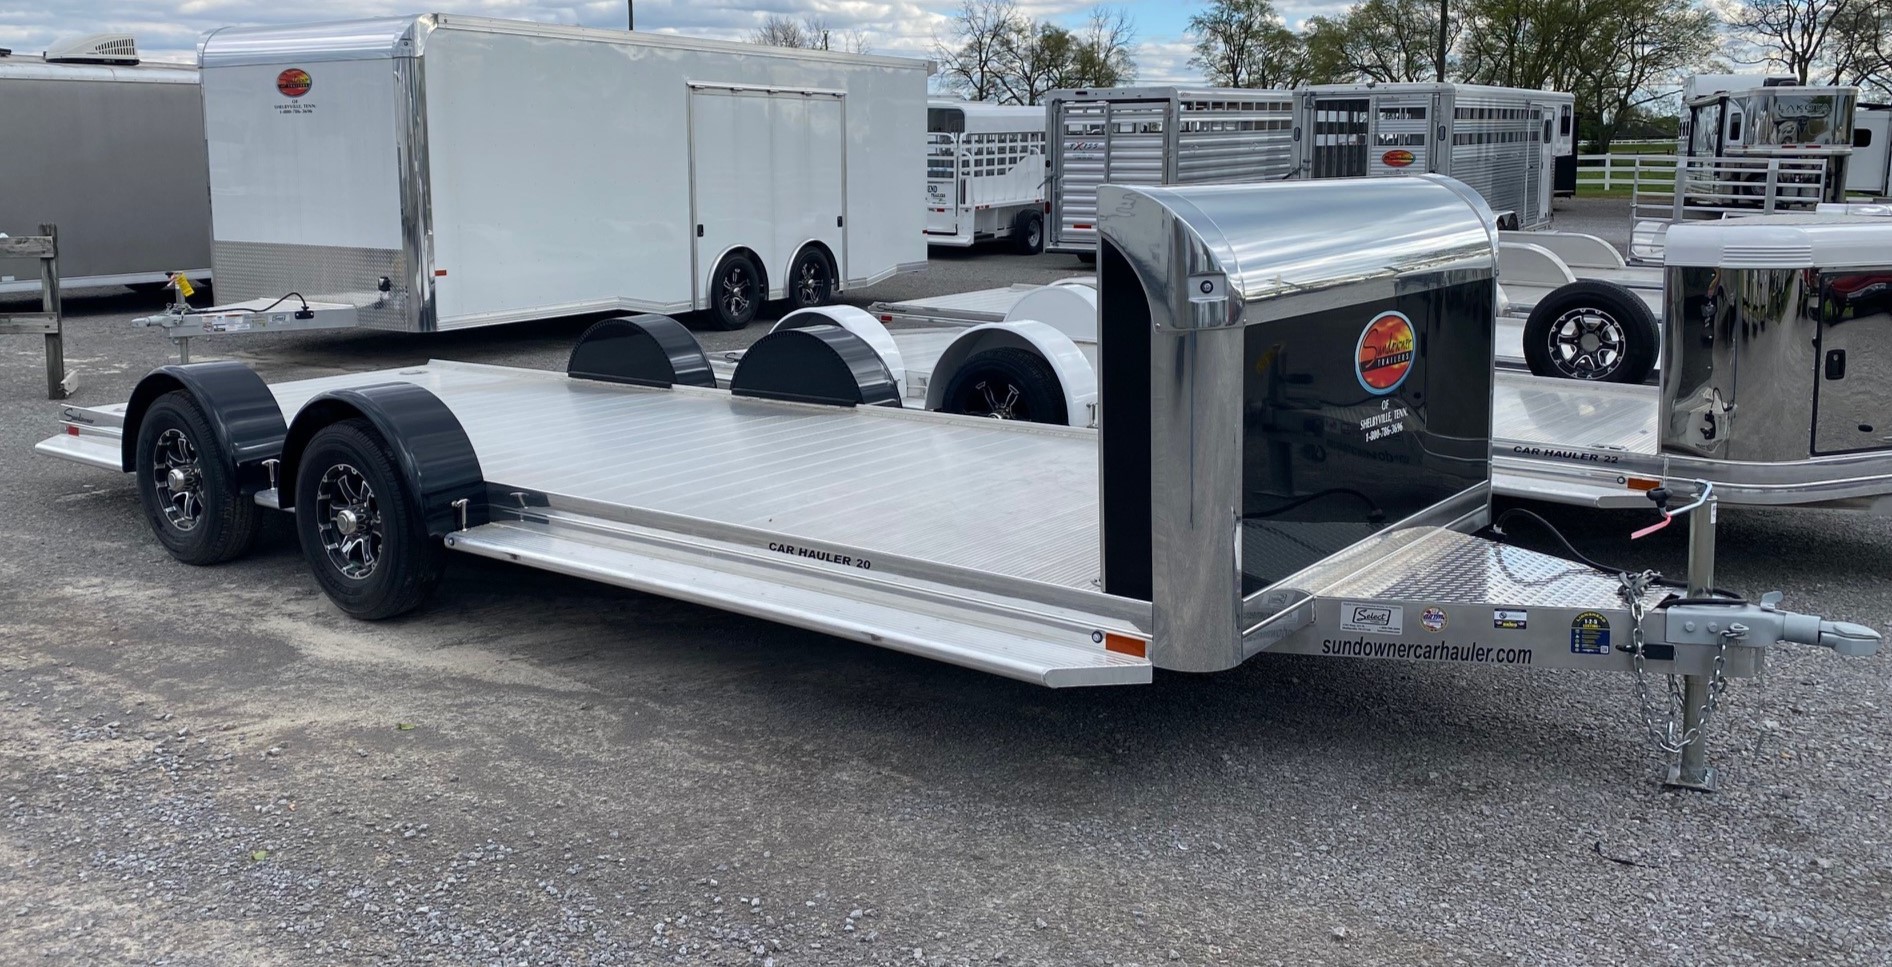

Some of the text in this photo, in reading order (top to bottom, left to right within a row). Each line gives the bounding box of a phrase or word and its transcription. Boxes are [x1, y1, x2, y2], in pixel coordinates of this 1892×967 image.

[1778, 103, 1832, 113] LAKOTA
[1362, 328, 1412, 369] Sundowner
[1377, 352, 1410, 368] TRAILERS
[1381, 399, 1390, 411] OF
[1513, 445, 1619, 464] CAR HAULER 22
[768, 542, 871, 570] CAR HAULER 20
[1356, 609, 1387, 621] Select
[1322, 636, 1532, 664] sundownercarhauler.com
